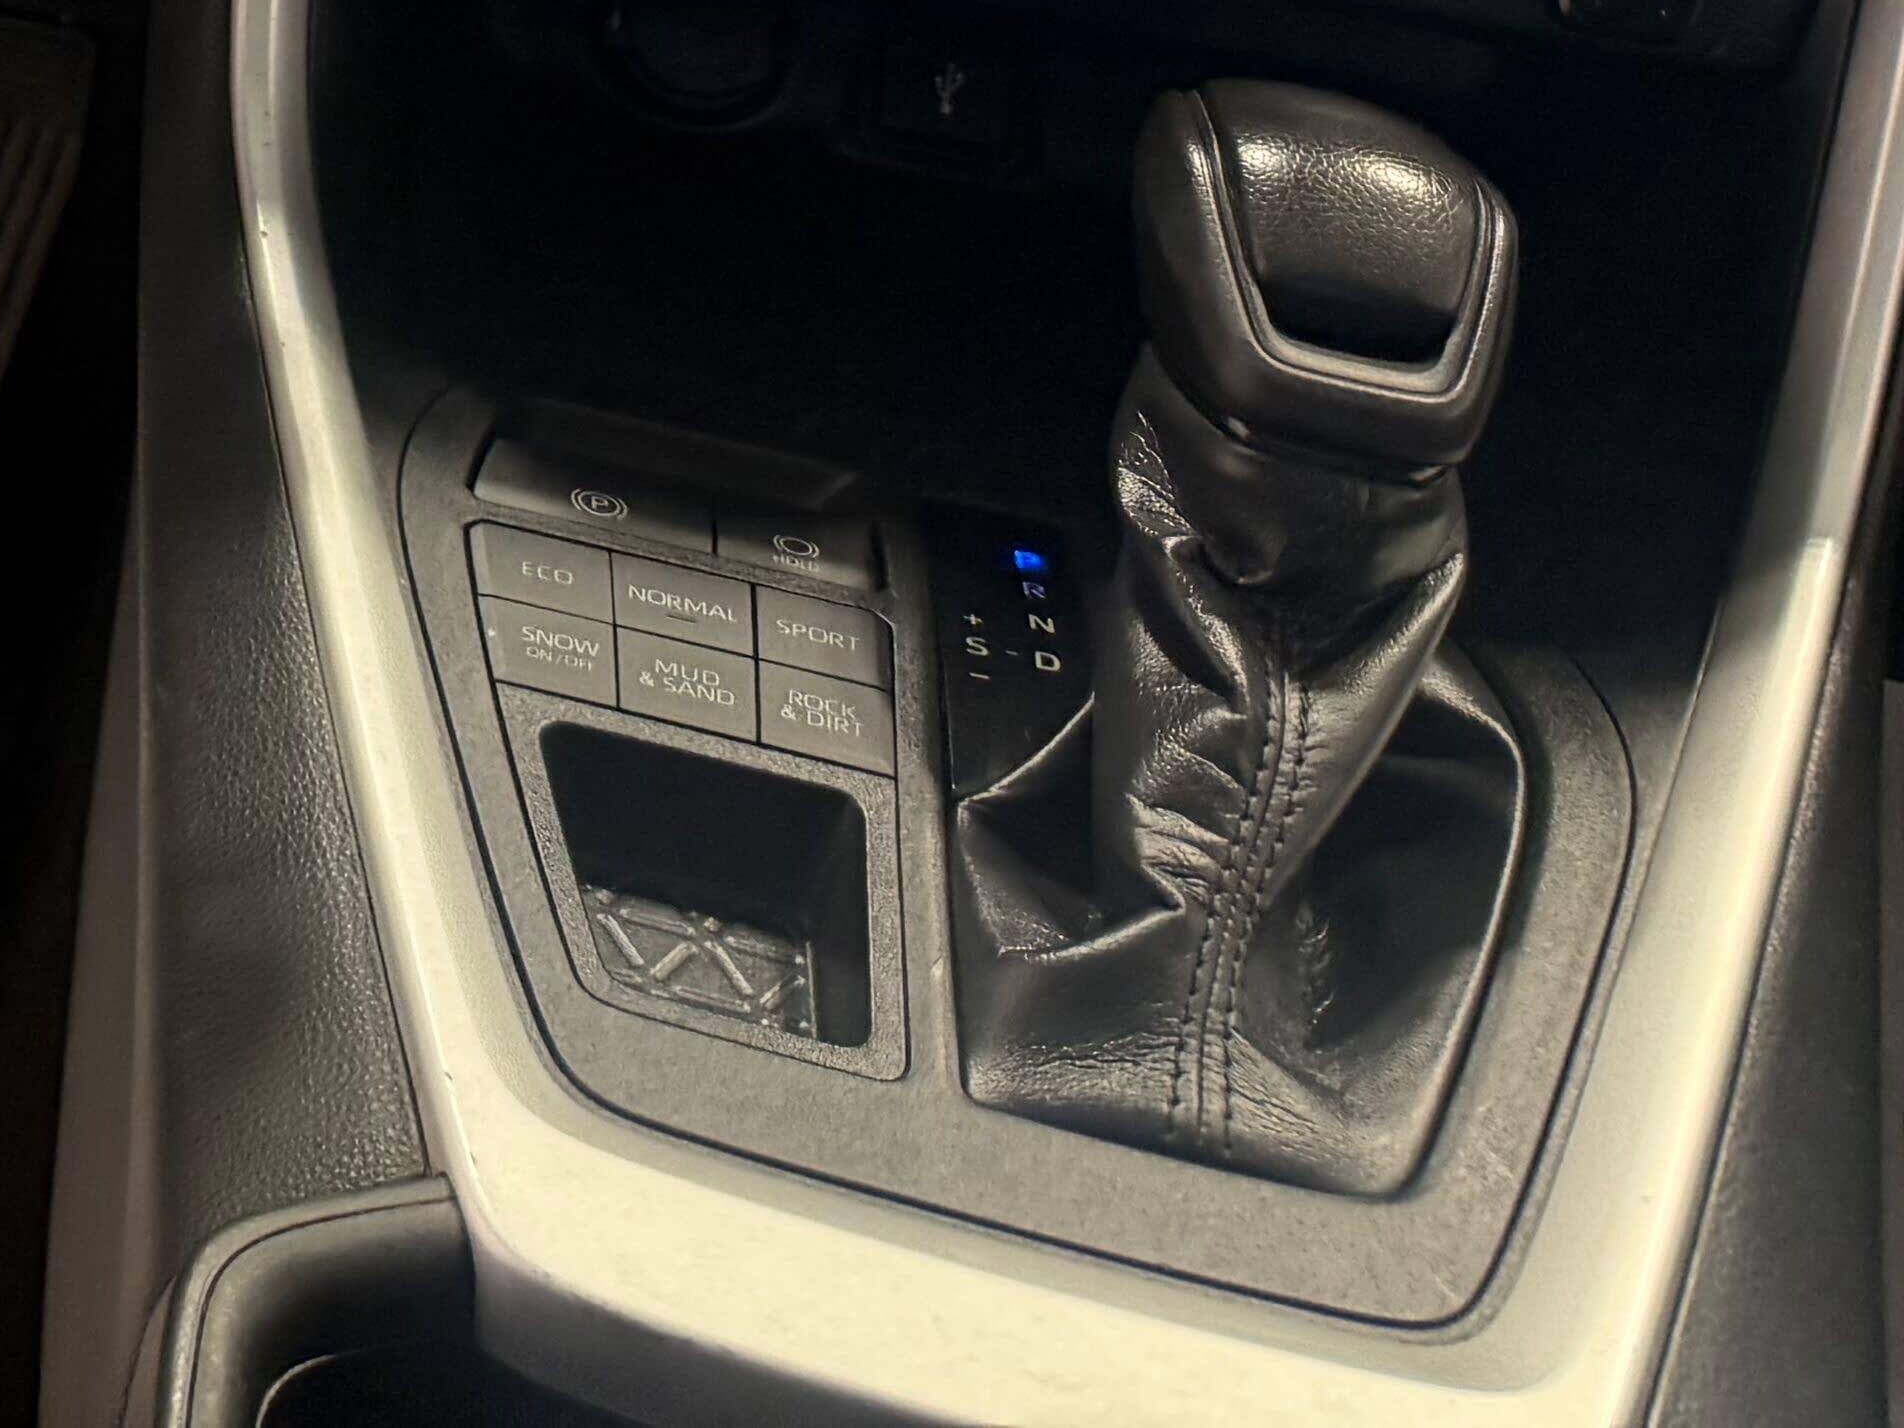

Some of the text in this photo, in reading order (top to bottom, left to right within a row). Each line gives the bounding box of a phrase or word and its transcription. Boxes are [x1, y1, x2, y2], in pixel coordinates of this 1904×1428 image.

[521, 561, 574, 585] ECO
[628, 584, 738, 623] NORMAL
[1022, 581, 1046, 600] R
[776, 619, 860, 651] SPORT
[1028, 613, 1055, 634] N
[521, 626, 600, 657] SNOW
[965, 636, 989, 656] S
[655, 659, 720, 687] MUD
[1034, 651, 1062, 672] D
[639, 671, 736, 706] & SAND
[789, 690, 857, 721] ROCK
[780, 704, 864, 738] & DIRT
